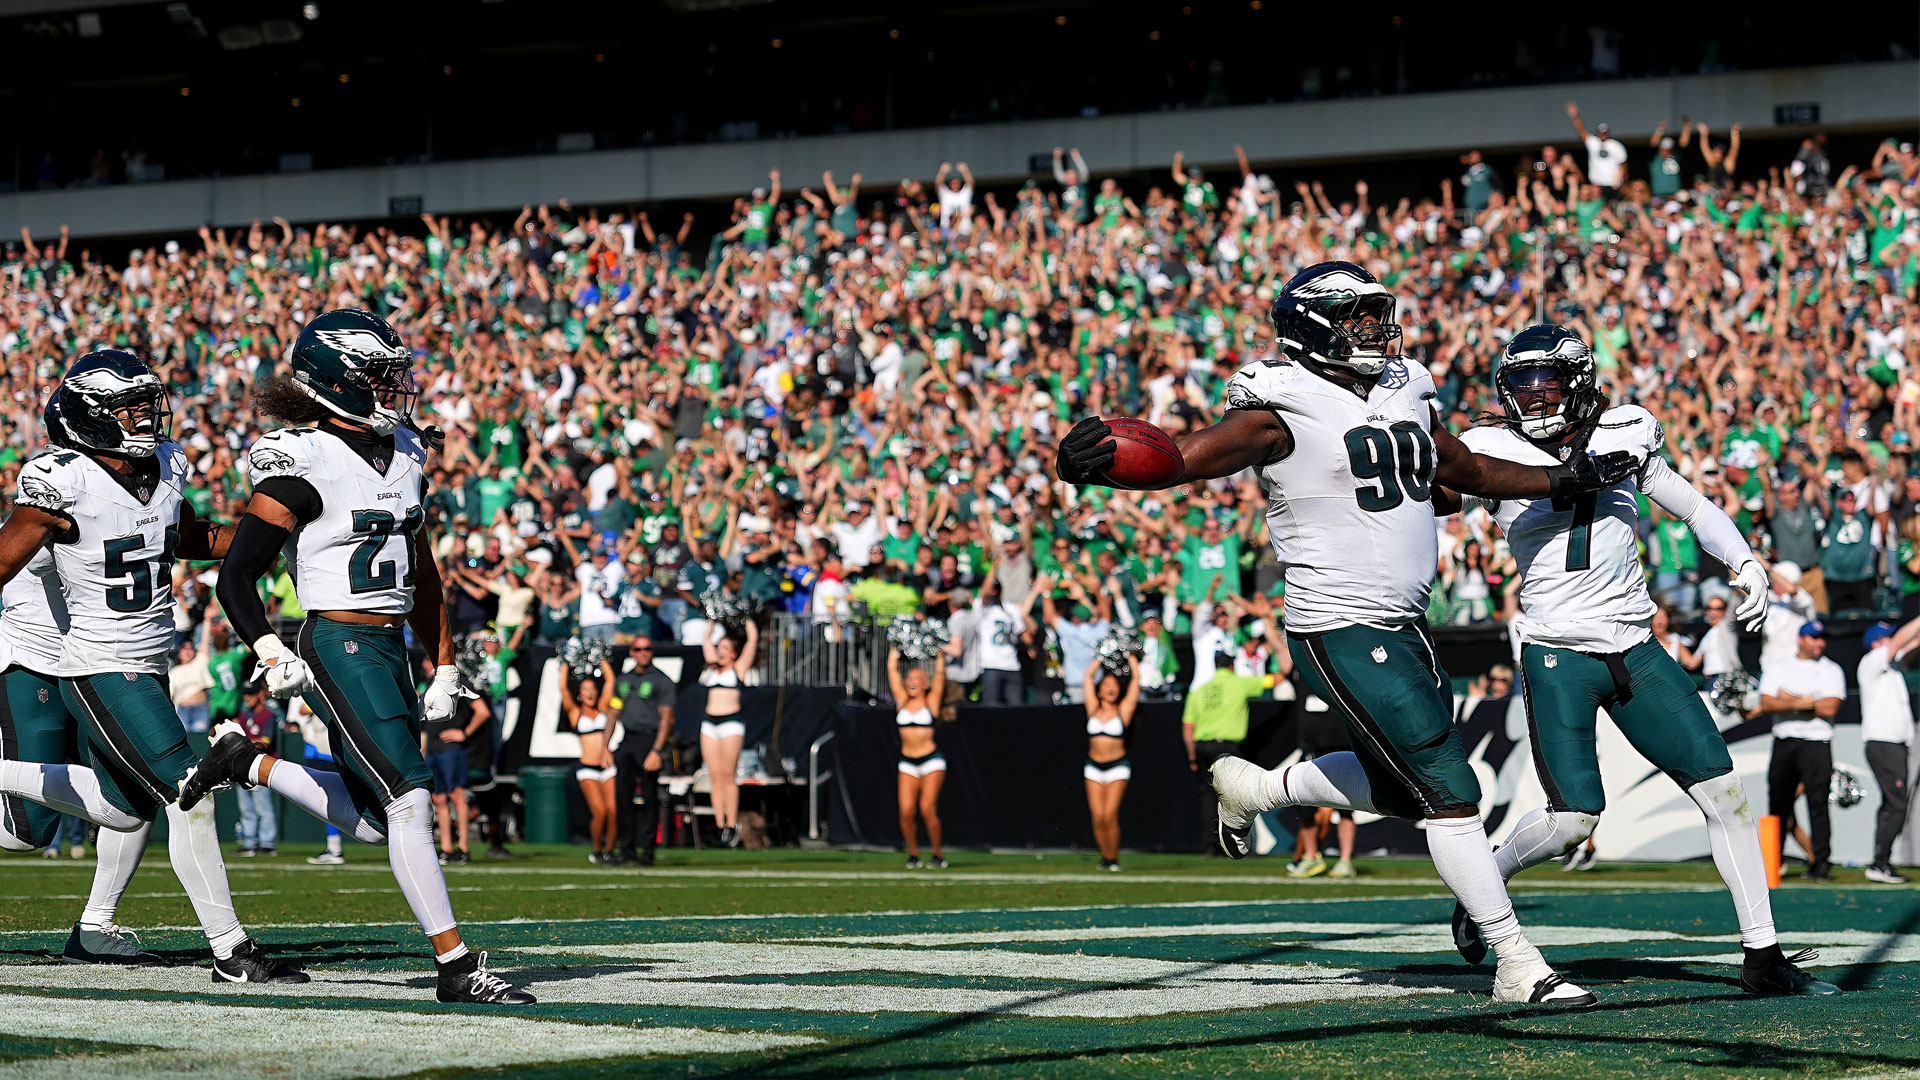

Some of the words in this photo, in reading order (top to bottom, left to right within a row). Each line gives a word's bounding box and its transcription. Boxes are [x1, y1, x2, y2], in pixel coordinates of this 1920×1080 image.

[1343, 420, 1434, 513] 90
[135, 515, 159, 527] EAGLES
[376, 491, 402, 501] EAGLES
[347, 504, 422, 595] 21
